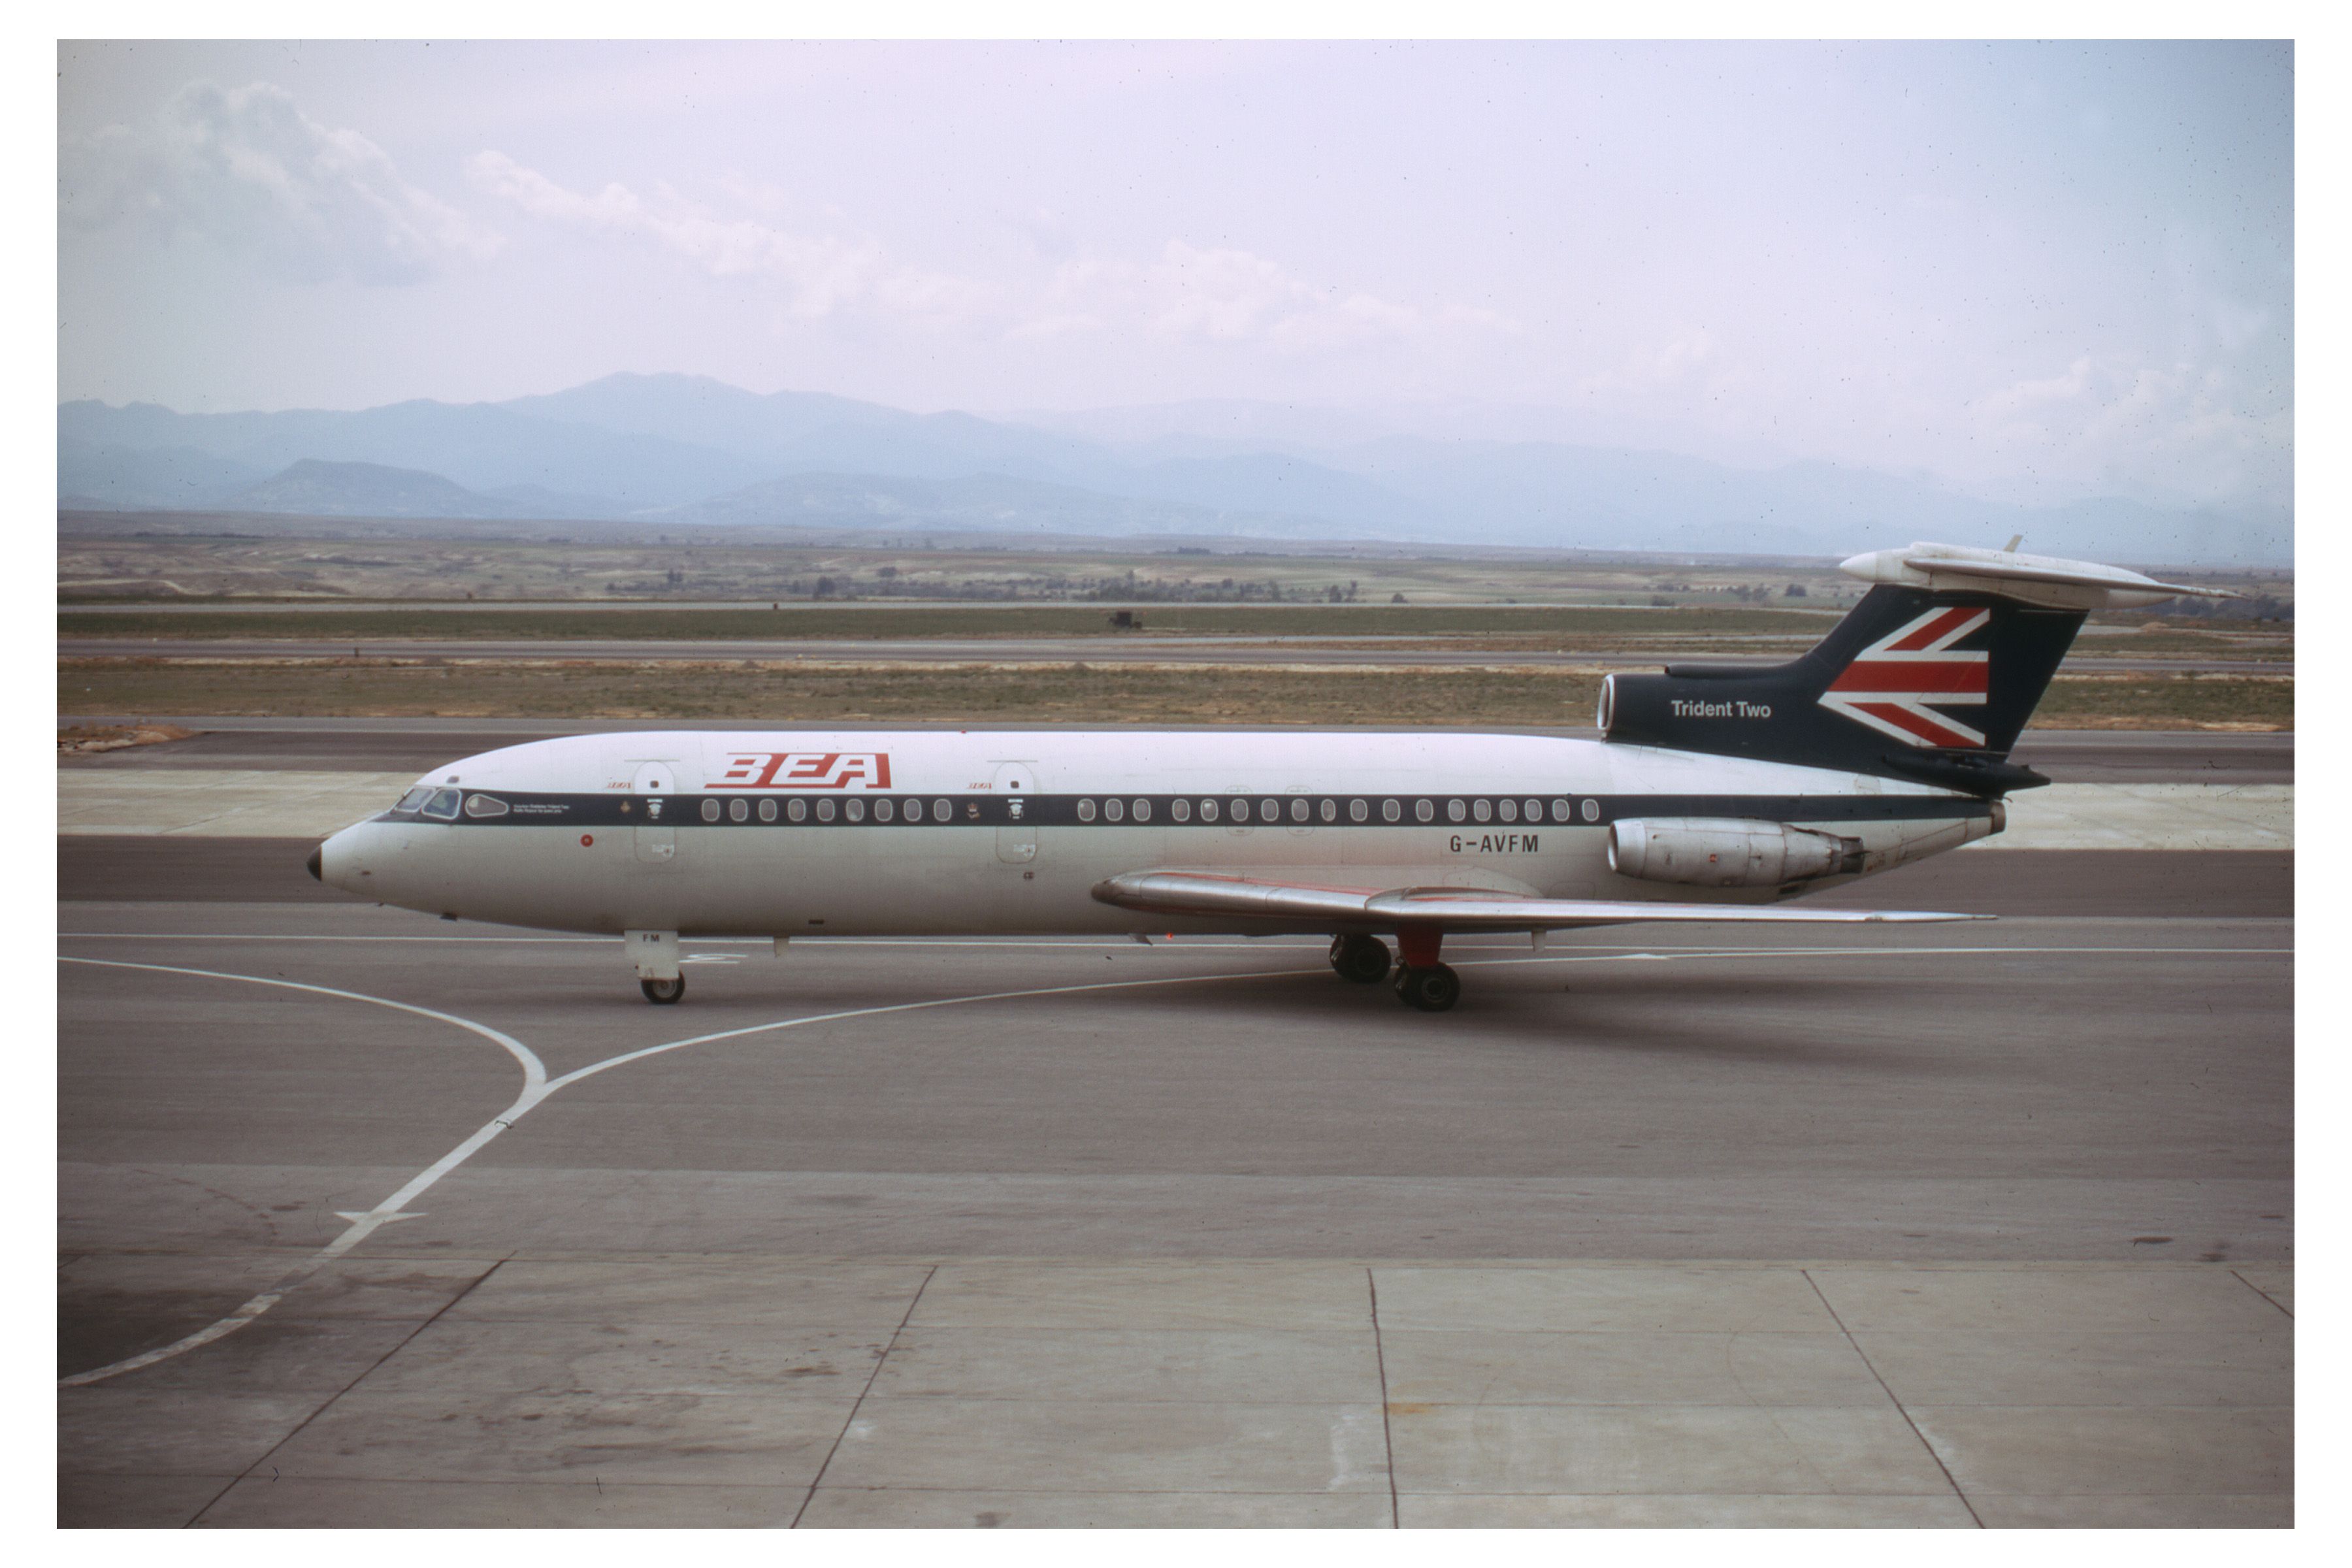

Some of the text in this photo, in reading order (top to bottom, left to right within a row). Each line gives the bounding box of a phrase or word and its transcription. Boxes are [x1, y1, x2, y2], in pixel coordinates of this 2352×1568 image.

[1671, 700, 1772, 718] Trident Two
[704, 753, 891, 789] BEA
[1450, 834, 1539, 853] G-AVFM
